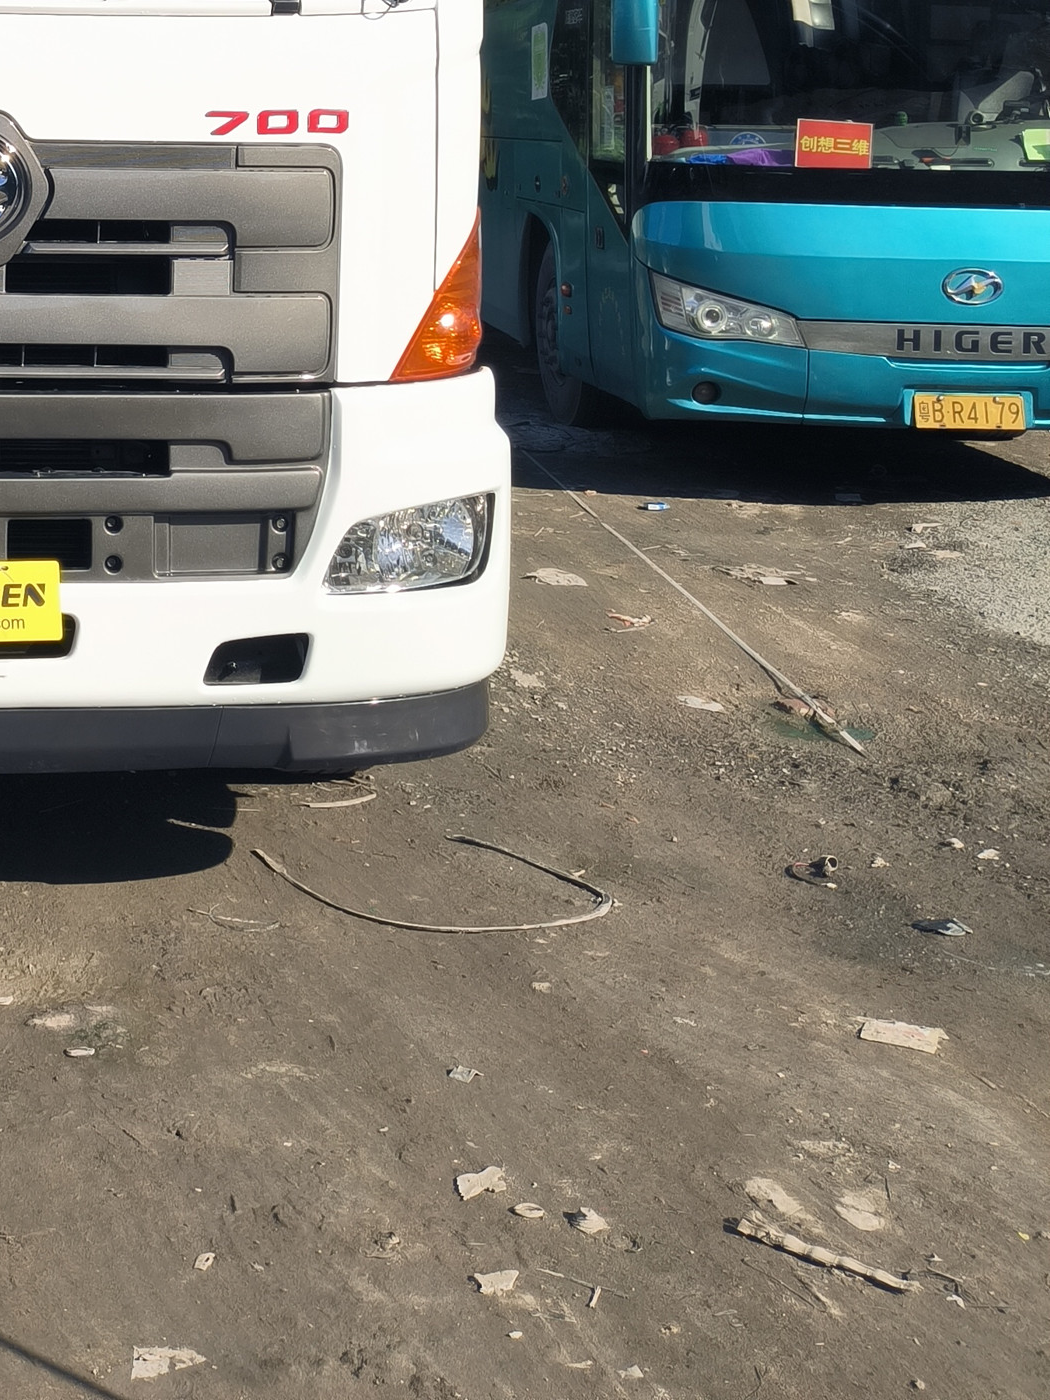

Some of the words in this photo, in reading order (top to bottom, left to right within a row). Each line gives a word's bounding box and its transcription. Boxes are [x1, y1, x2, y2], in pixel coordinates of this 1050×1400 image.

[205, 108, 349, 136] 700
[800, 135, 870, 156] 创想三维
[896, 328, 1047, 355] HIGER
